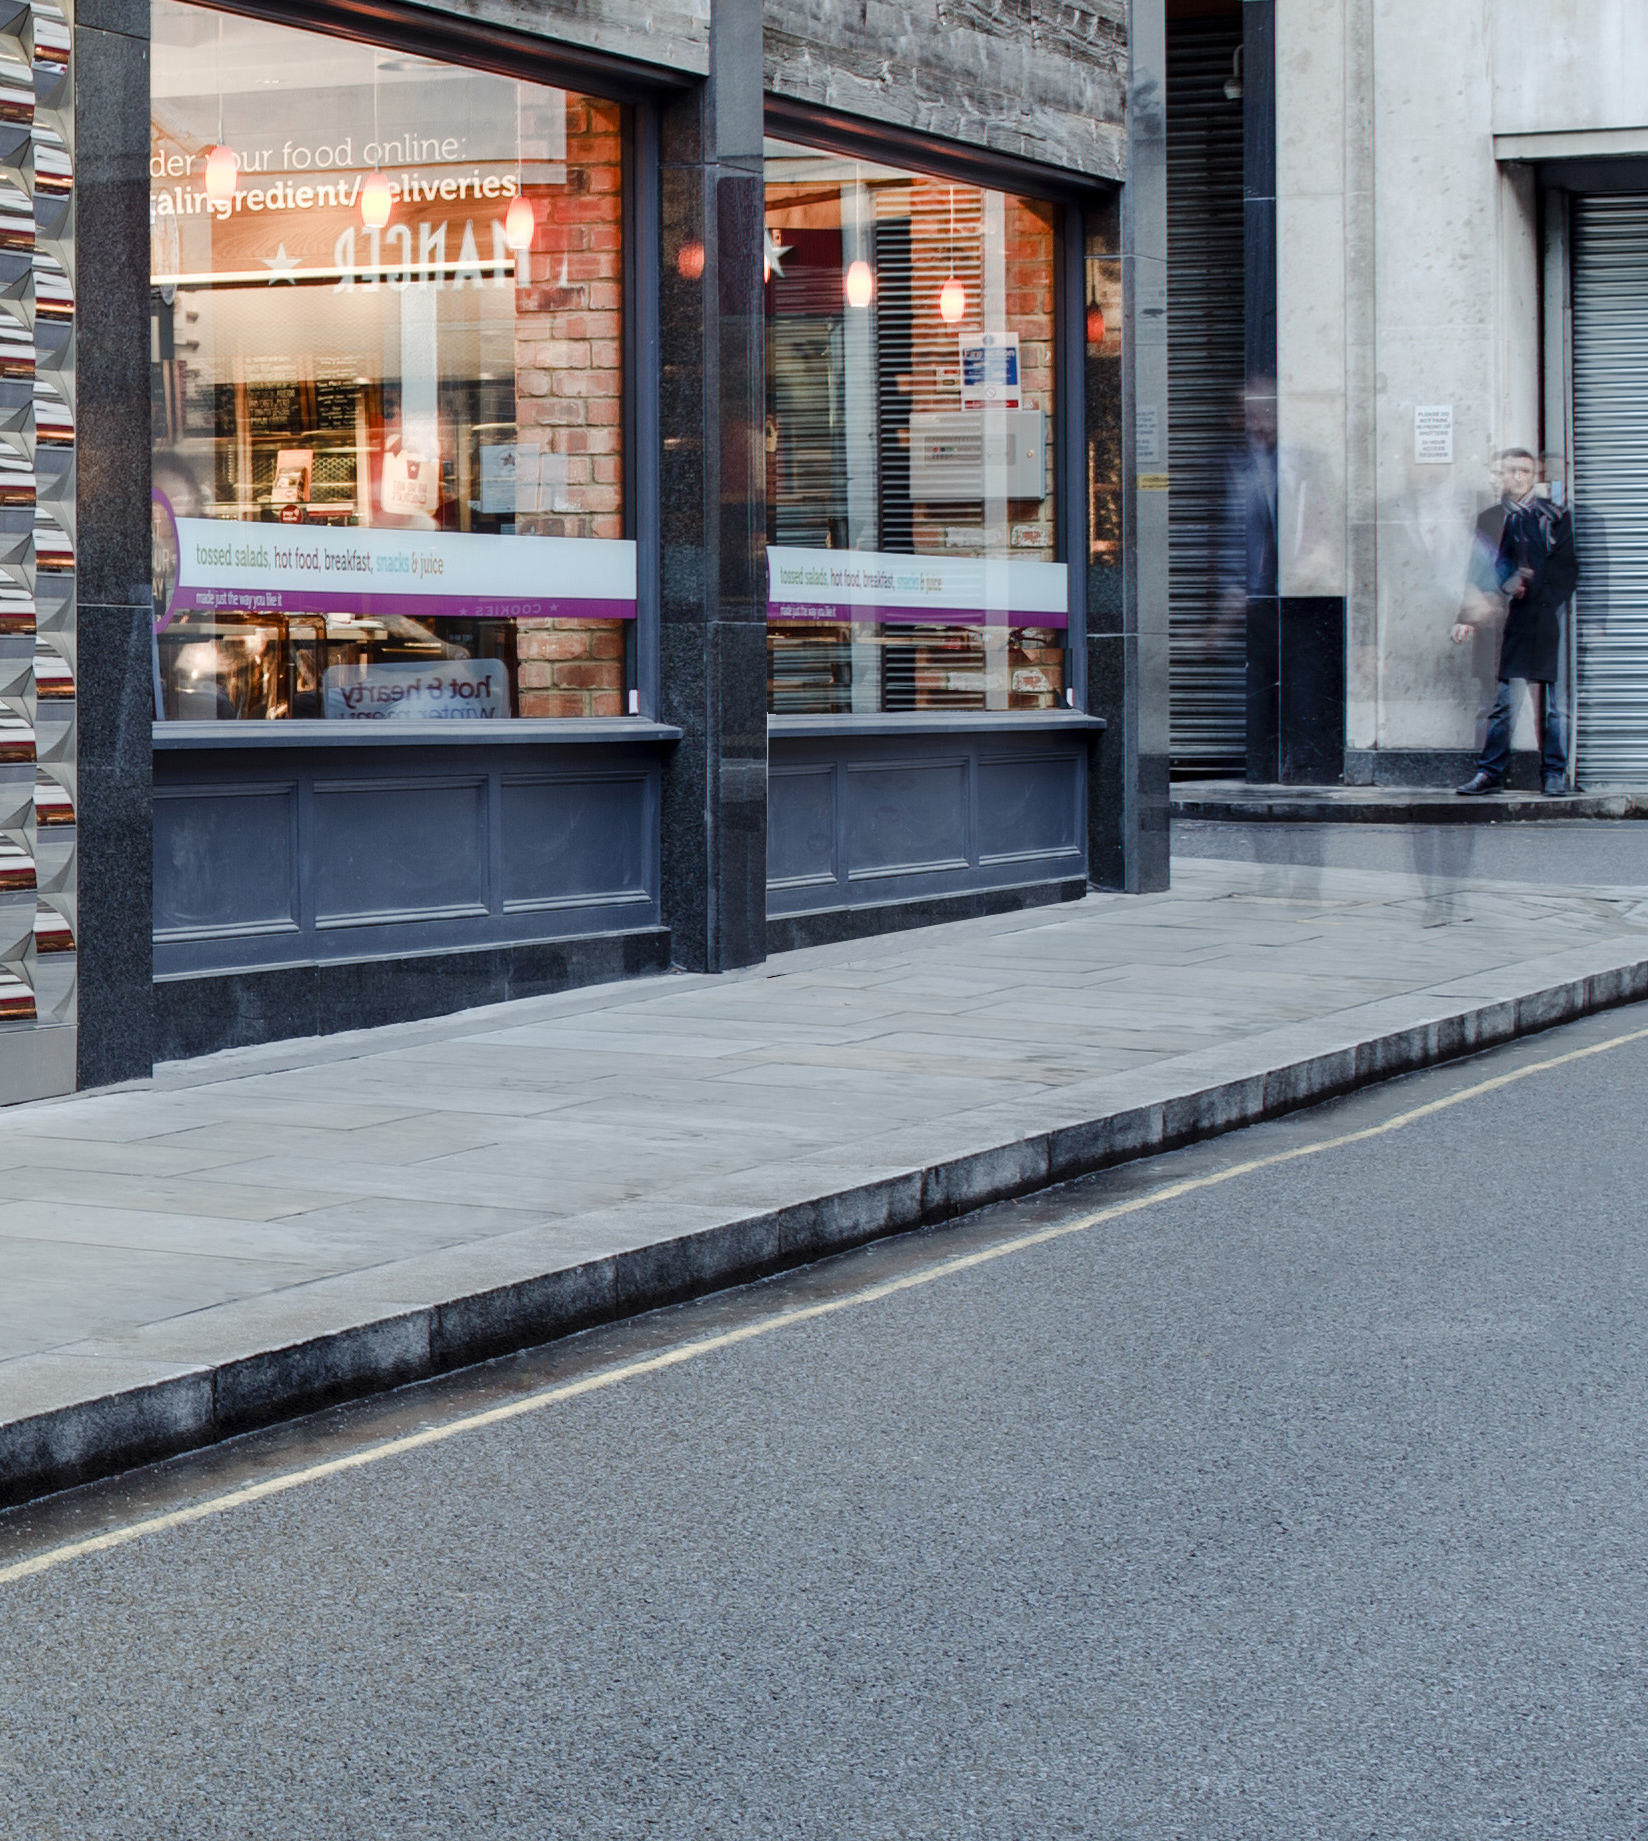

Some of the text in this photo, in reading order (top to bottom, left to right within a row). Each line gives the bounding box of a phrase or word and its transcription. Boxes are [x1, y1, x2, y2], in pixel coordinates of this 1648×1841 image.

[150, 134, 467, 178] der our food online:
[196, 543, 445, 579] tossed salads, hot food, breakfast, snacks & juice
[780, 566, 804, 585] tossed
[830, 568, 843, 587] hot
[196, 589, 215, 605] made
